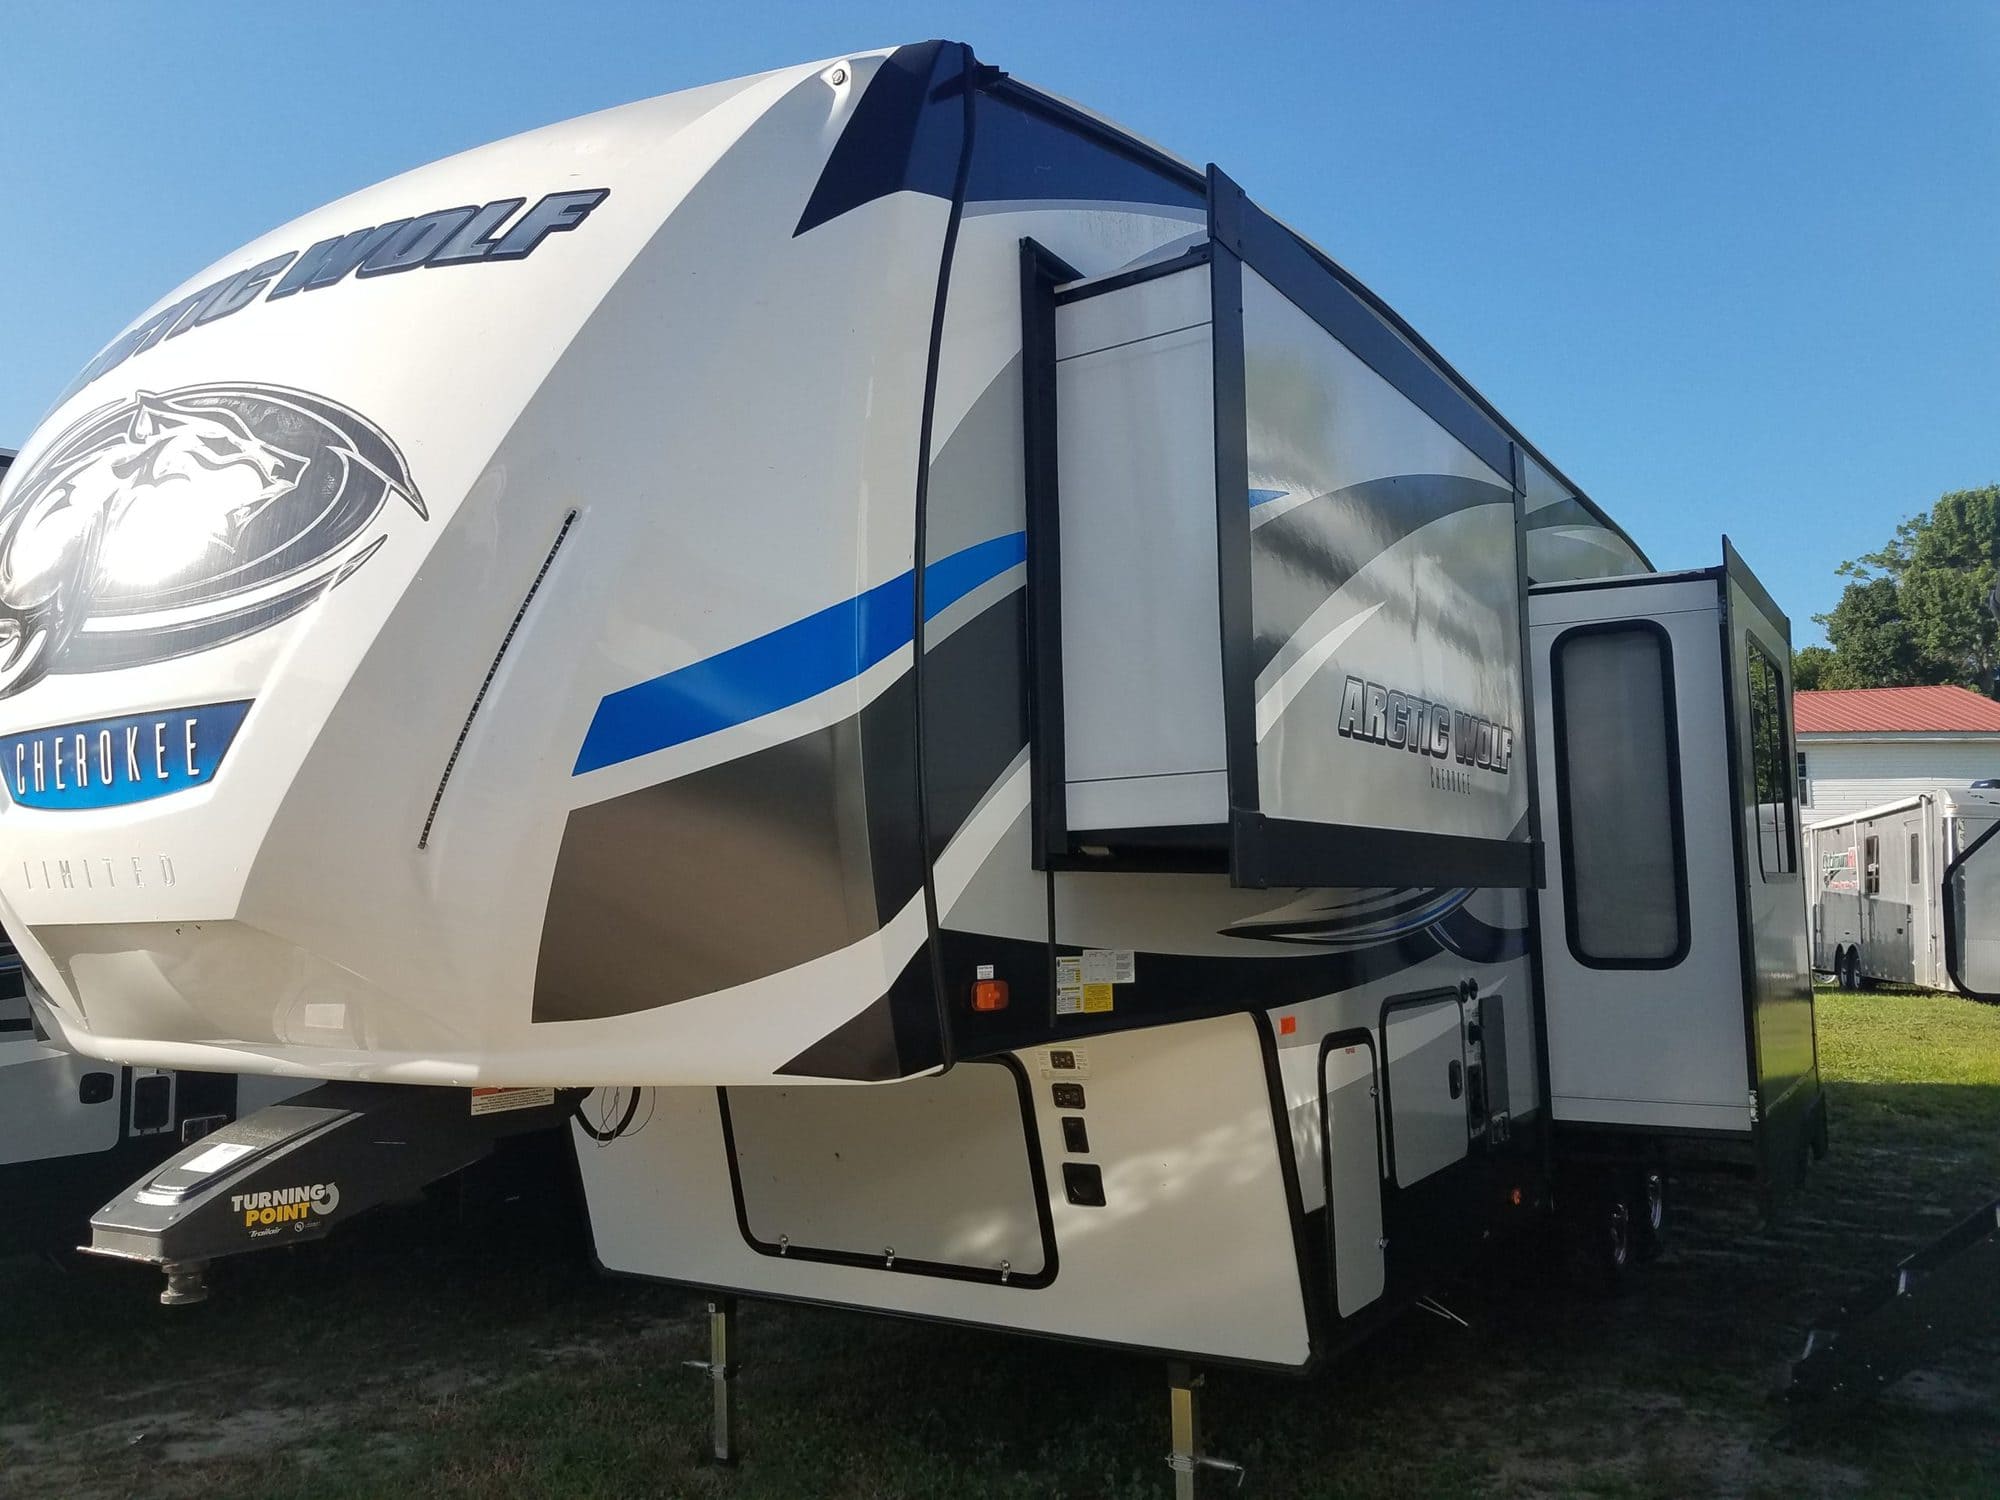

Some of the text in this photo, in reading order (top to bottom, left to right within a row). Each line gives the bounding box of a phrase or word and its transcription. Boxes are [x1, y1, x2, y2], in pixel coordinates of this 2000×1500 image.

[265, 188, 610, 302] WOLF
[1338, 675, 1513, 774] ARCTIC WOLF
[16, 718, 200, 795] CHEROKEE
[22, 854, 177, 890] LIMITED
[231, 1184, 326, 1212] TURNING
[246, 1202, 310, 1227] POINT
